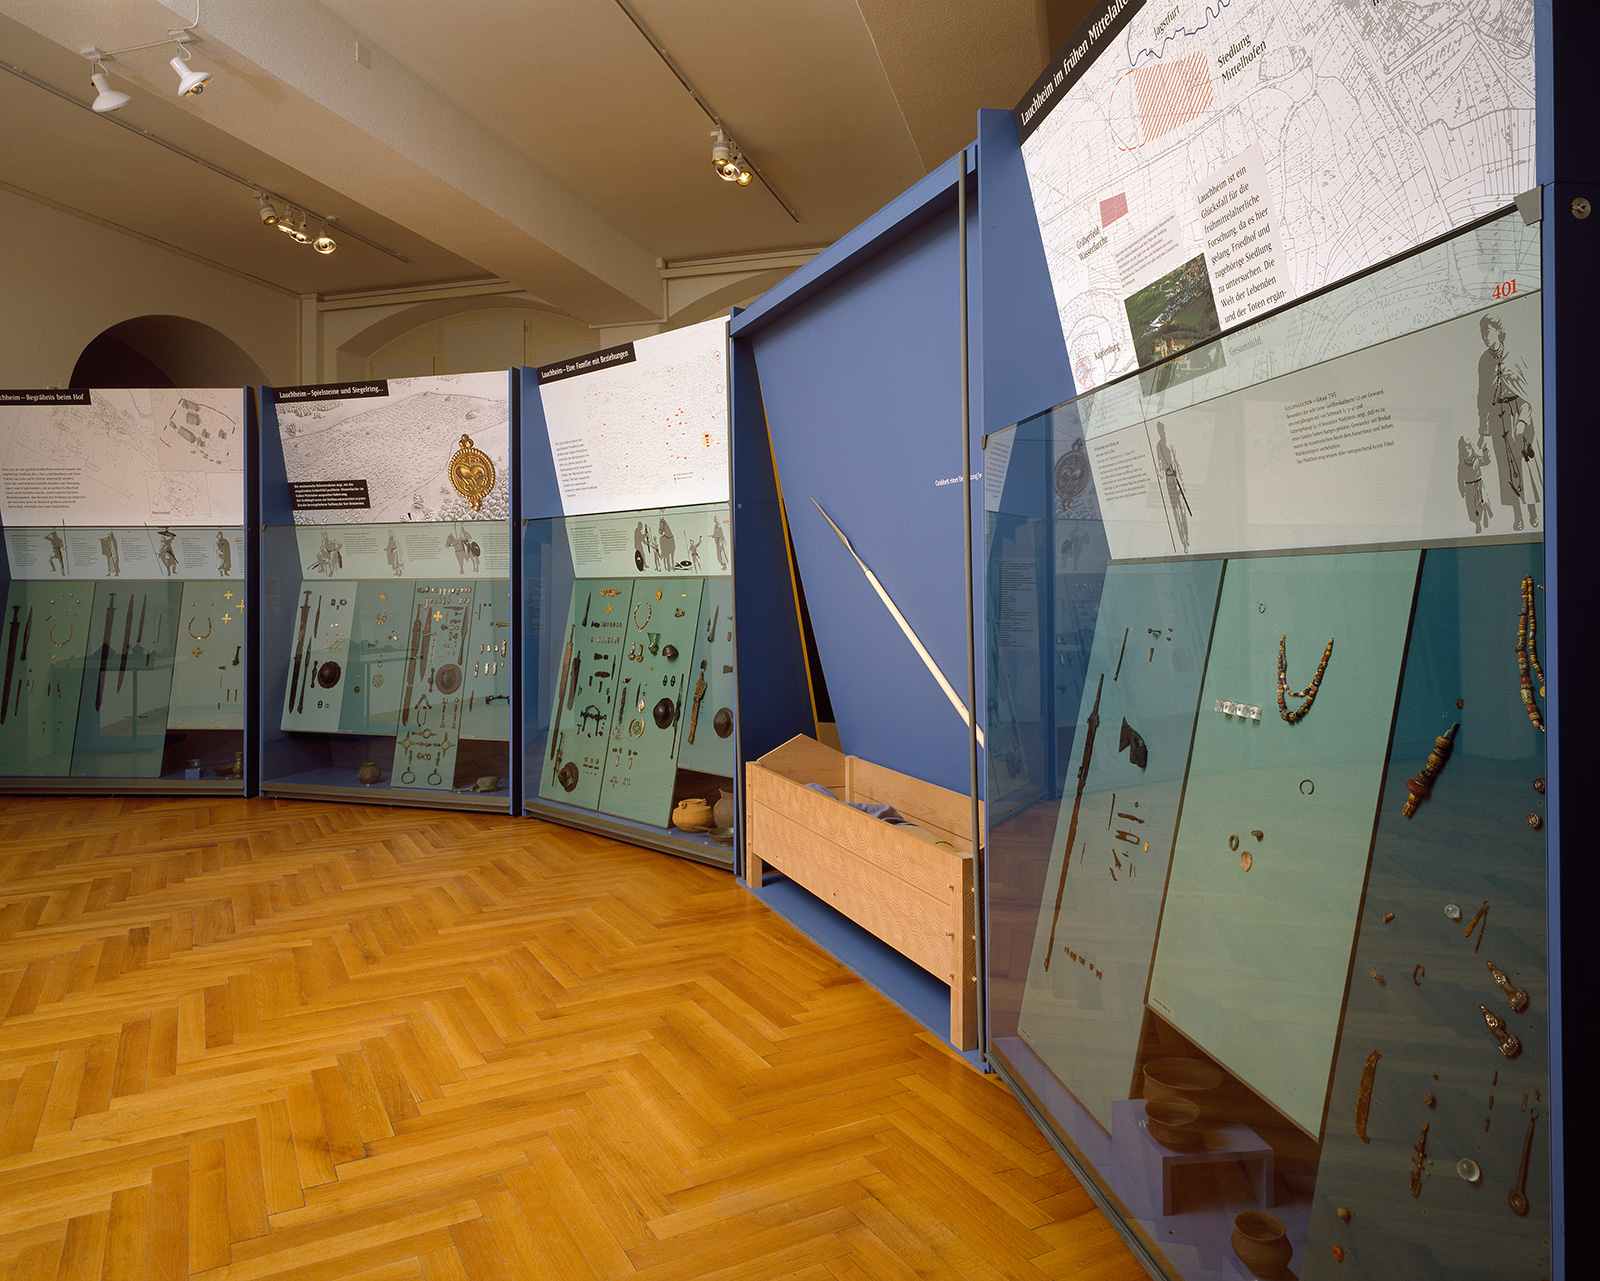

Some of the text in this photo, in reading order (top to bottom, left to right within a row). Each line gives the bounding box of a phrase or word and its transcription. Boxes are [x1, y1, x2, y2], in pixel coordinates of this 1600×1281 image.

[1217, 32, 1252, 68] Siedlung
[1220, 40, 1268, 84] Mittelhofen
[1020, 82, 1054, 126] Lauchheim
[1053, 70, 1064, 88] im
[1063, 39, 1089, 74] frühen
[1197, 166, 1247, 204] Lauchheim ist ein
[1200, 182, 1250, 219] Glücksfall für die
[1204, 194, 1260, 234] frühmittelalterliche
[1238, 220, 1247, 230] da
[1247, 216, 1255, 225] es
[1254, 207, 1268, 220] hier
[1231, 230, 1257, 252] Friedhof
[1258, 222, 1271, 237] und
[1214, 242, 1273, 279] zugehörige Siedlung
[1218, 259, 1276, 293] zu untersuchen. Die
[1220, 276, 1277, 308] Welt der Lebenden
[1492, 278, 1518, 300] 401
[1224, 312, 1236, 323] und
[1236, 307, 1247, 317] der
[1247, 298, 1266, 312] Toten
[576, 359, 591, 370] Familie
[600, 350, 629, 364] Beziehungen
